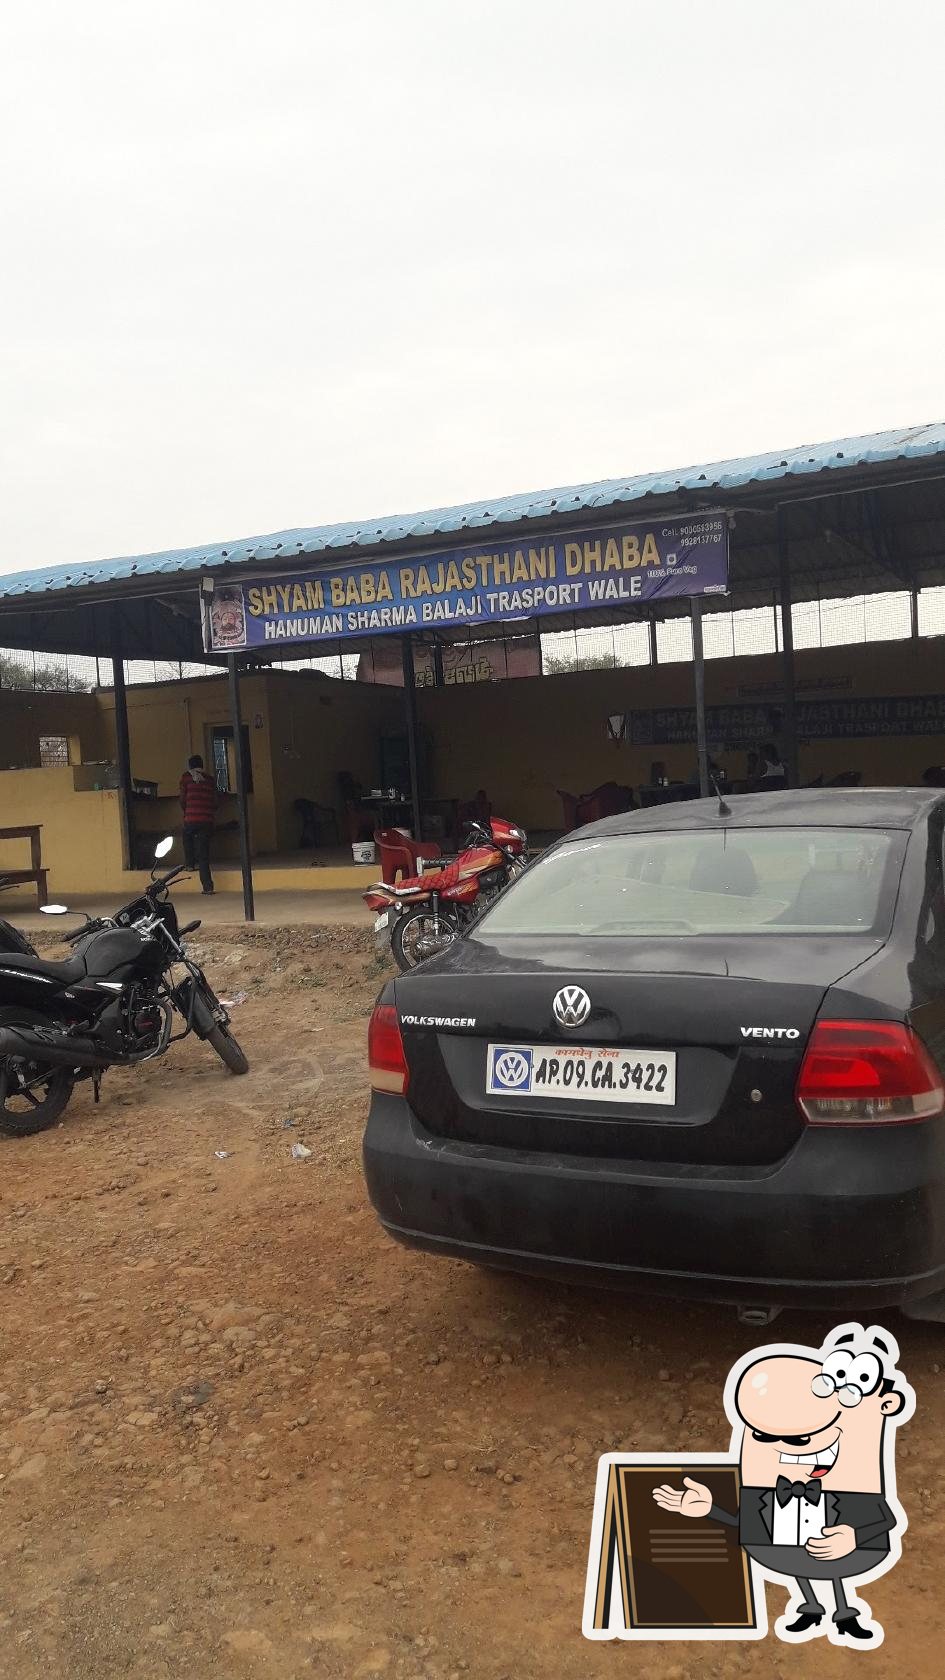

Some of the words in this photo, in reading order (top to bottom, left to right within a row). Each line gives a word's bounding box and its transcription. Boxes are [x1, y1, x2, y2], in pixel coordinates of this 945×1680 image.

[249, 580, 325, 617] SHYAM
[330, 570, 394, 607] BABA
[399, 545, 557, 599] RAJASTHANI
[564, 533, 661, 577] DHABA
[264, 613, 343, 640] HANUMAN
[347, 605, 417, 632] SHARMA
[422, 596, 482, 622] BALAJI
[487, 582, 583, 613] TRASPORT
[588, 575, 642, 601] WALE
[401, 1015, 476, 1027] VOLKSWAGEN
[740, 1027, 800, 1039] VENTO
[535, 1058, 668, 1092] AP.09.CA.3422
